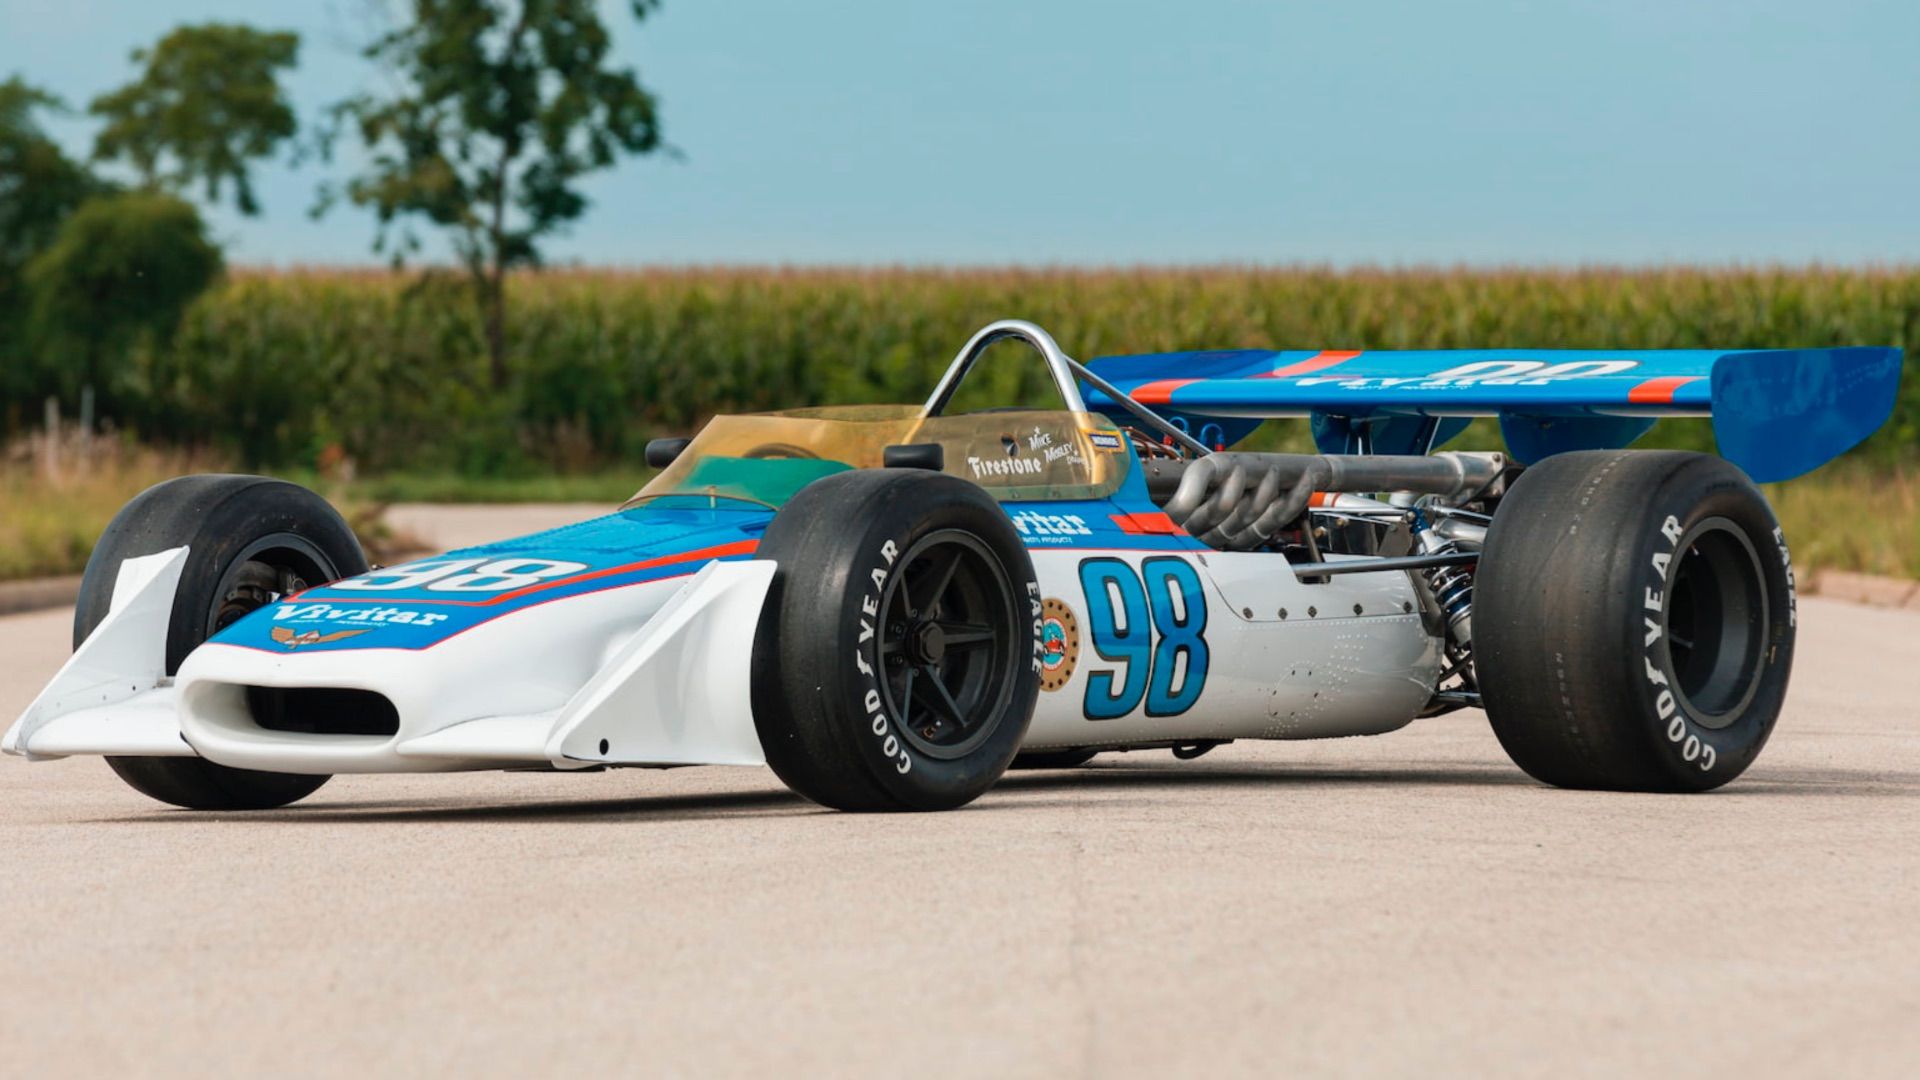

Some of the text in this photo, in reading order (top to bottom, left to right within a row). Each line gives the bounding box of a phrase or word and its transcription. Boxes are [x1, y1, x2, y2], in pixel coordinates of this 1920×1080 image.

[1028, 433, 1052, 451] MIKE
[1011, 511, 1093, 535] vitar
[328, 557, 593, 592] 98
[272, 604, 449, 626] Vivitar
[1026, 581, 1044, 677] EAGLE
[1078, 555, 1210, 721] 98
